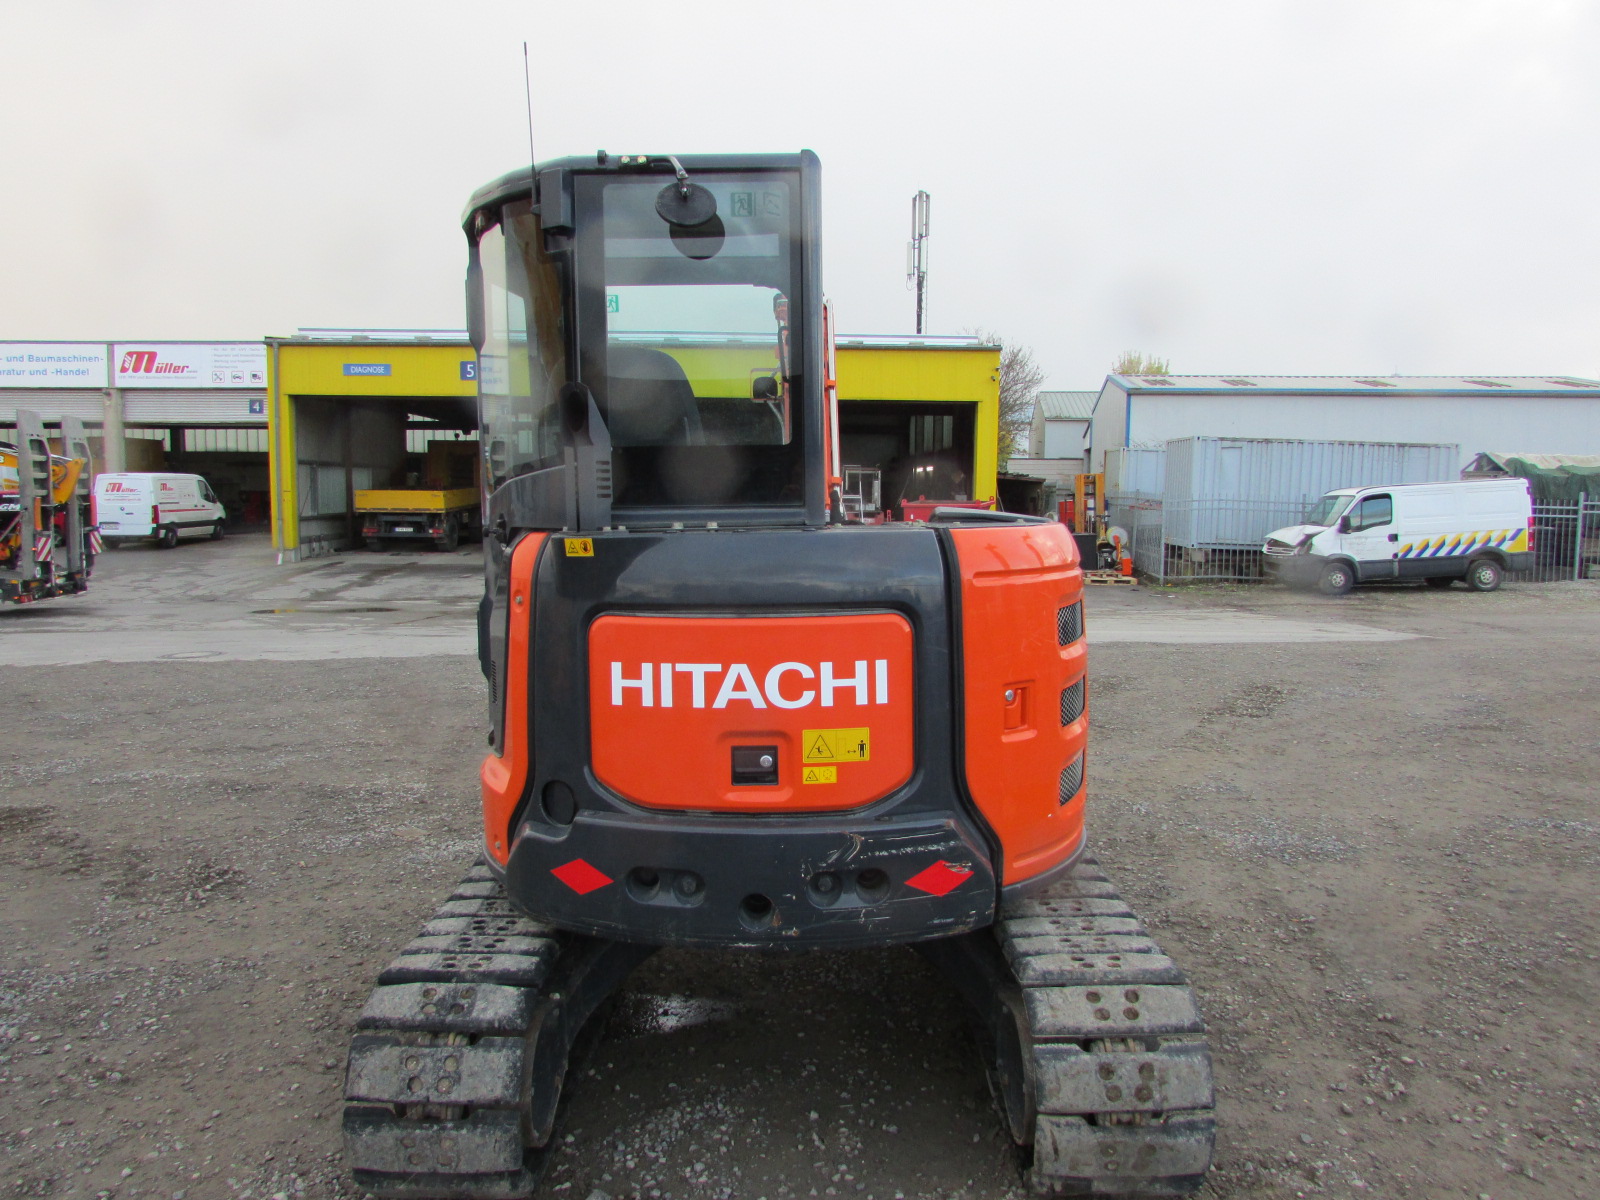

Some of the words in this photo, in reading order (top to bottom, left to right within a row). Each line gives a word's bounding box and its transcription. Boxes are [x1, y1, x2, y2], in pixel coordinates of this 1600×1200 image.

[28, 354, 104, 362] Baumaschinen-
[119, 350, 189, 373] Müller
[29, 368, 47, 376] und
[51, 368, 90, 376] -Handel
[466, 364, 474, 377] 5
[252, 402, 260, 411] 4
[611, 659, 888, 708] HITACHI
